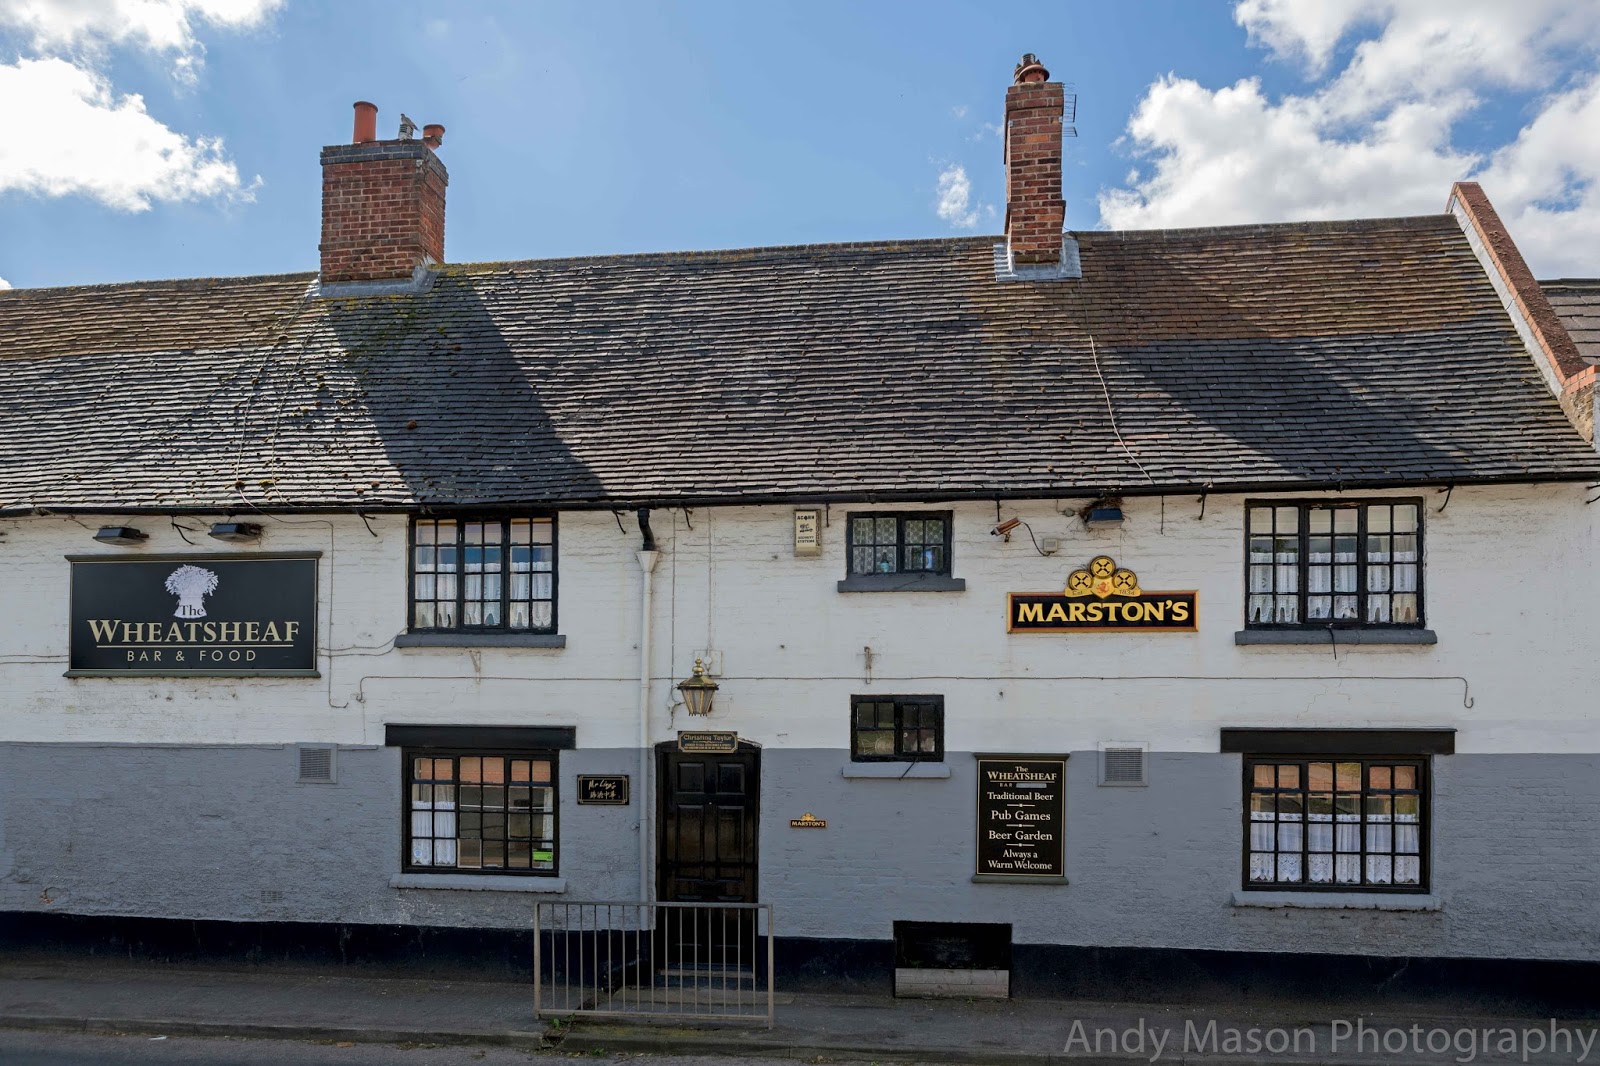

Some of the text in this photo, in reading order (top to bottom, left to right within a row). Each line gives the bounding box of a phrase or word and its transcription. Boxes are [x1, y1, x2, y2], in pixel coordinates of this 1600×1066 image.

[179, 604, 204, 617] The
[1017, 599, 1189, 623] MARSTON'S
[87, 619, 300, 643] WHEATSHEAF
[127, 650, 257, 662] BAR & FOOD
[986, 771, 1058, 781] WHEATSHEAF
[986, 791, 1054, 801] Traditional Beer
[990, 809, 1051, 821] Pub Games
[988, 829, 1053, 841] Beer Garden
[1002, 849, 1031, 861] Always
[987, 860, 1053, 870] Warm Welcome
